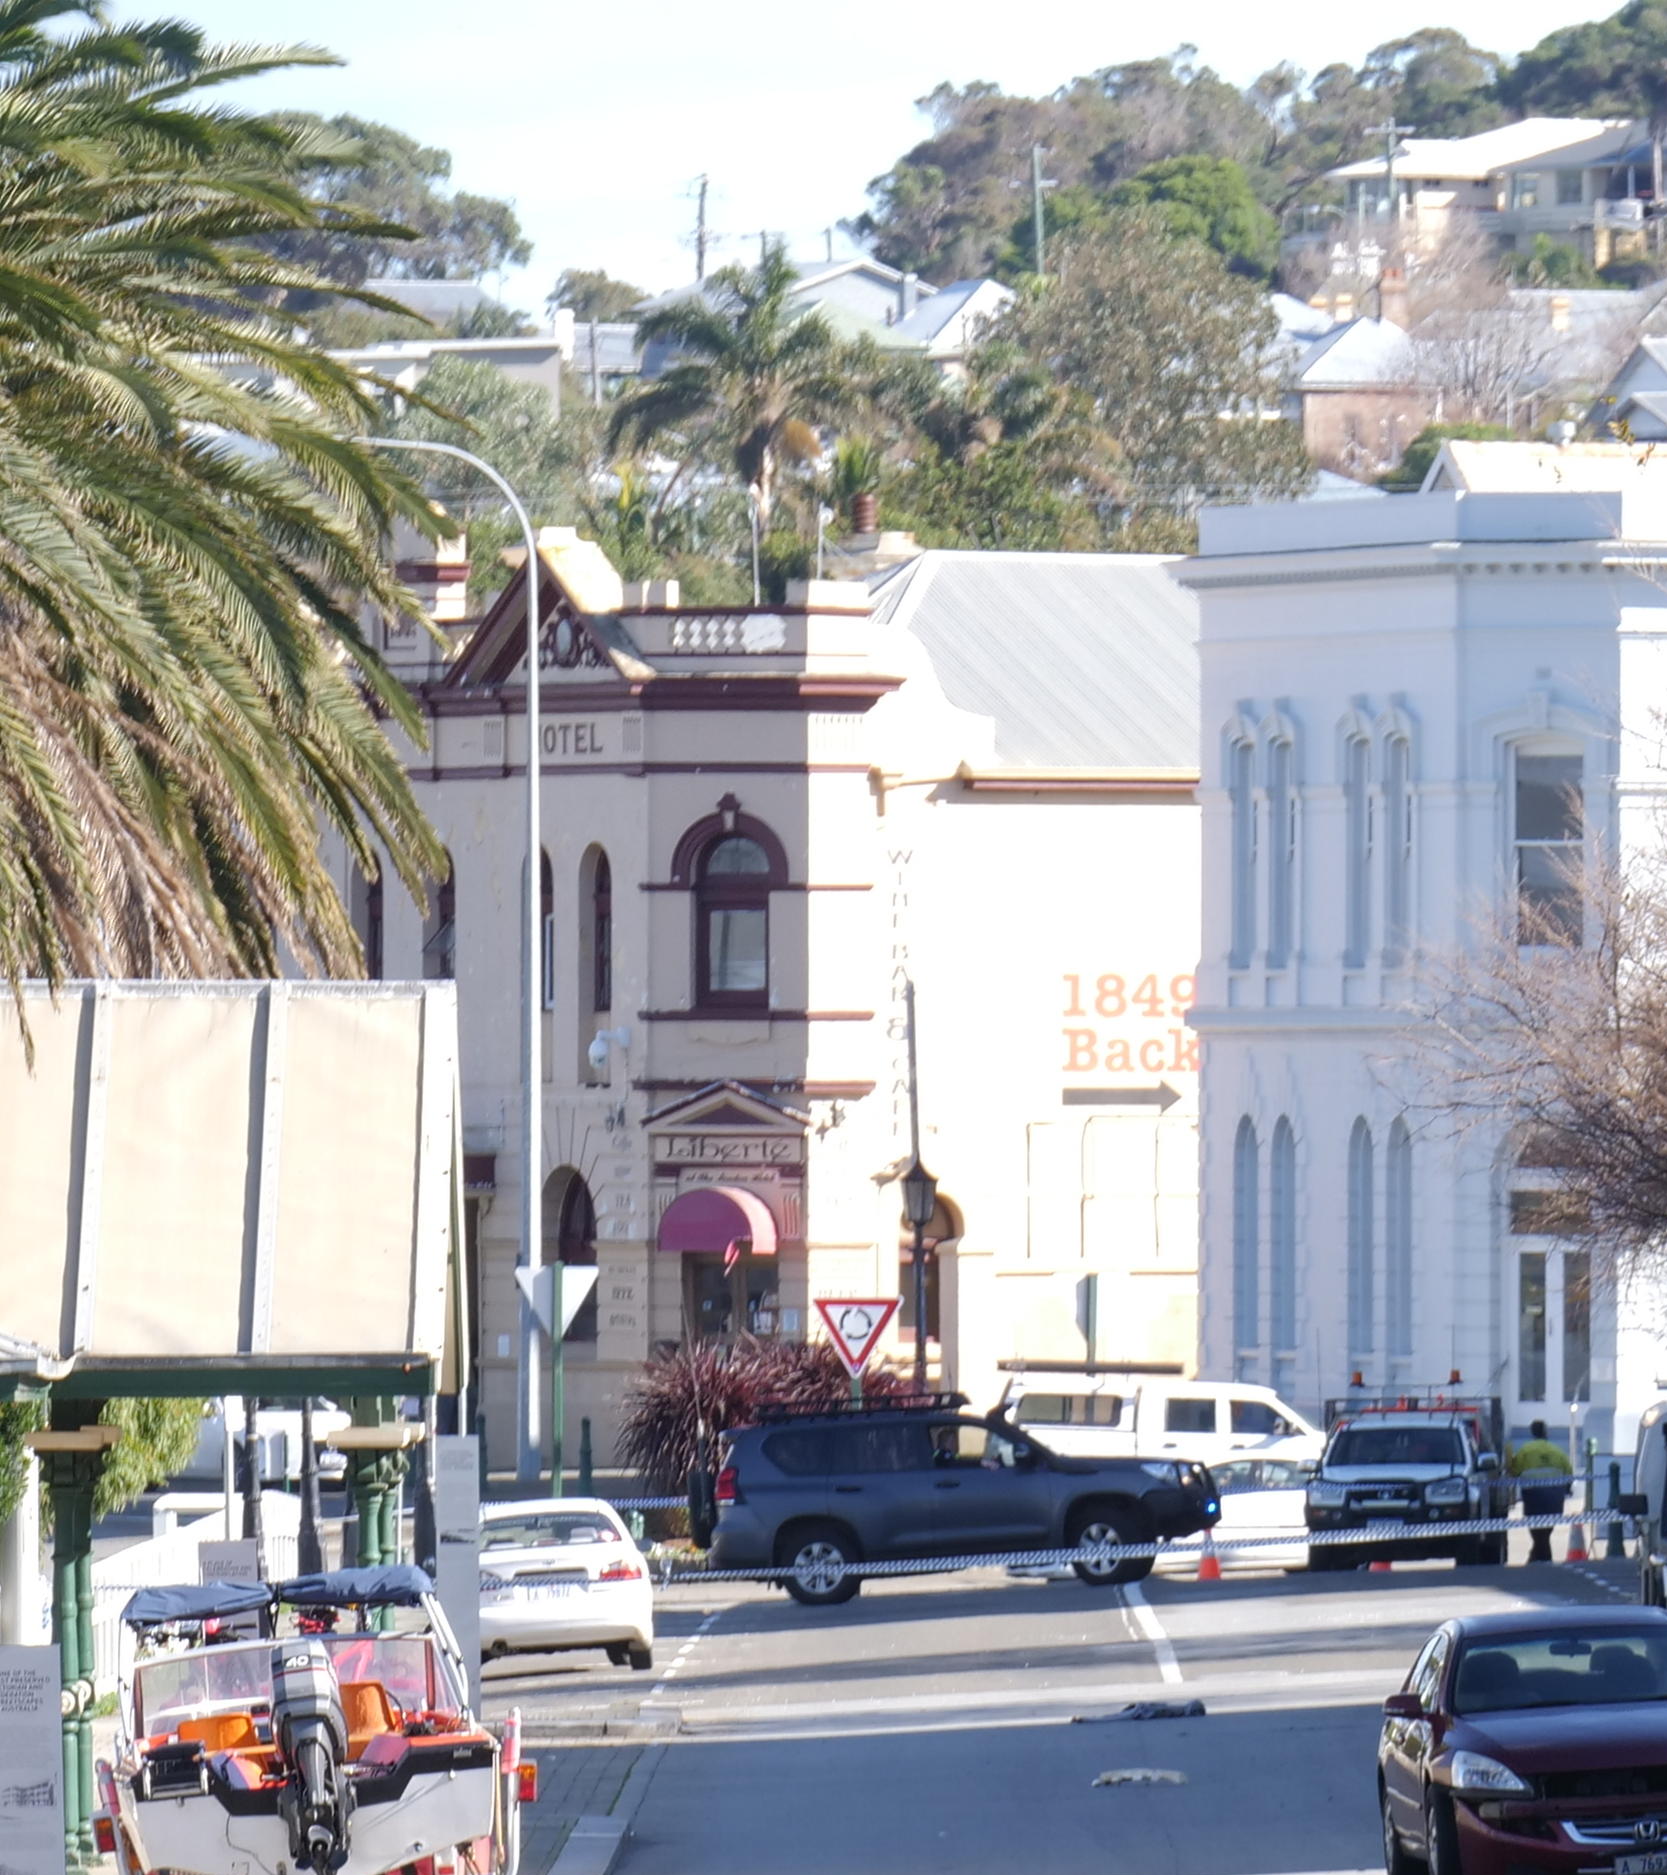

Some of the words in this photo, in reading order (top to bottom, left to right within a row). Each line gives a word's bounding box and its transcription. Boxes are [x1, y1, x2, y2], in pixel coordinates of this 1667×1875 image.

[539, 722, 603, 754] OTEL
[1062, 974, 1197, 1017] 1849
[1062, 1028, 1202, 1072] Back
